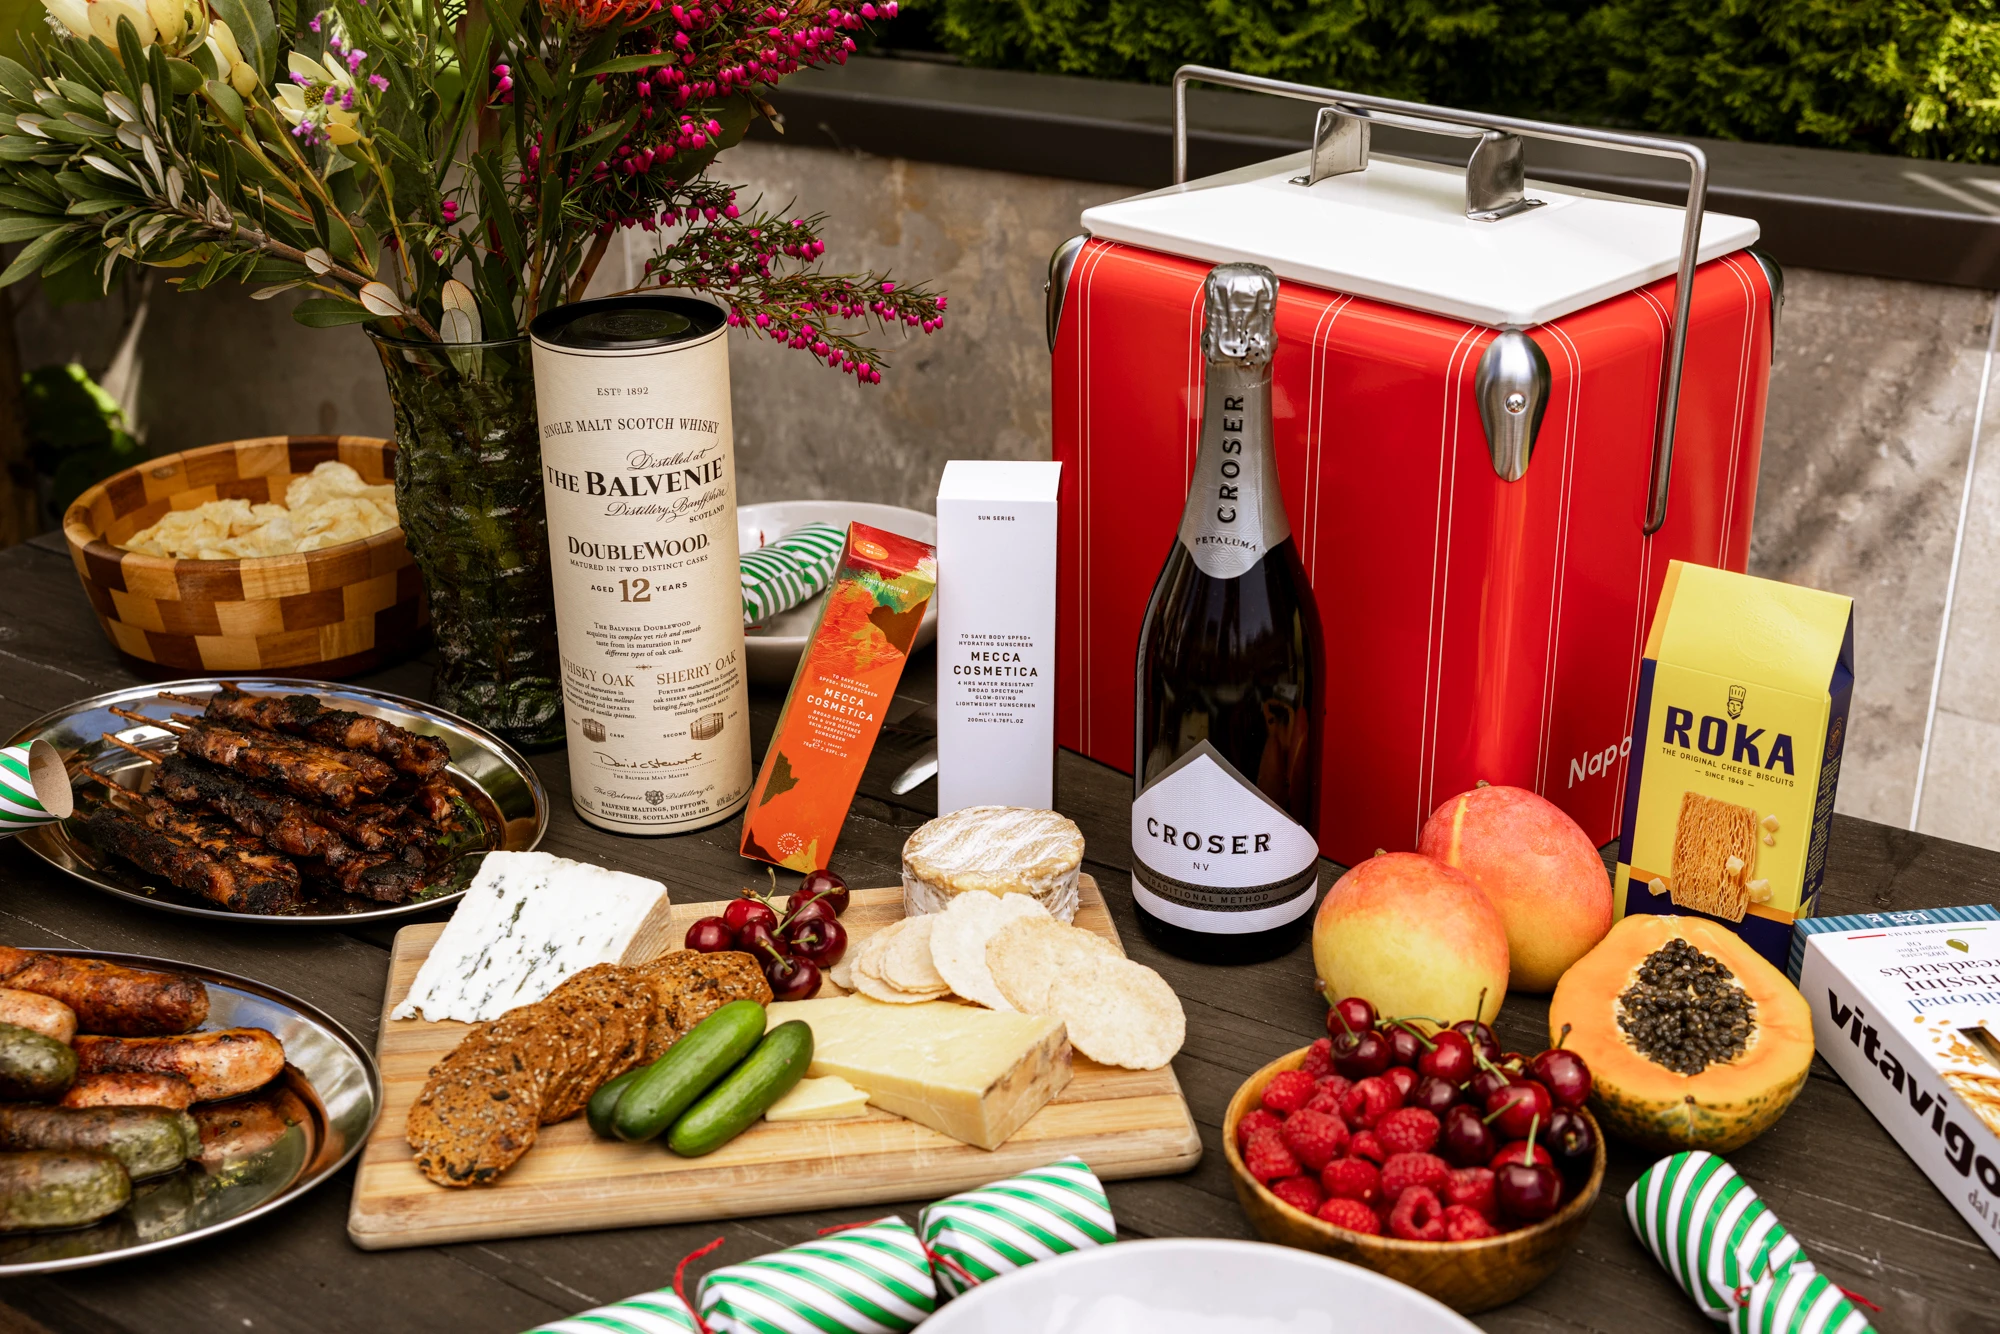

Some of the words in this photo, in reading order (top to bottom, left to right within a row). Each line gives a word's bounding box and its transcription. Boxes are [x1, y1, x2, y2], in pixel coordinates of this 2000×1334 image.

[627, 387, 649, 396] 1892
[544, 421, 574, 438] SINGLE
[576, 418, 612, 432] MALT
[618, 418, 674, 430] SCOTCH
[680, 418, 720, 434] WHISKY
[626, 449, 691, 471] Distilled
[1217, 395, 1244, 523] CROSER
[546, 464, 580, 493] THE
[666, 484, 729, 524] Banffshire
[689, 504, 725, 523] SCOTLAND
[1195, 536, 1256, 552] PETALUMA
[570, 558, 604, 572] MATURED
[642, 561, 684, 572] DISTINCT
[686, 554, 709, 566] CASKS
[590, 584, 615, 593] AGED
[618, 578, 651, 603] 12
[656, 581, 688, 592] YEARS
[864, 577, 886, 587] LIMITED
[887, 584, 909, 594] EDITION
[669, 630, 681, 638] and
[682, 624, 702, 635] smooth
[605, 649, 629, 658] different
[971, 652, 1020, 662] MECCA
[562, 654, 597, 682] WHISKY
[602, 672, 635, 687] OAK
[656, 663, 711, 685] SHERRY
[716, 650, 737, 670] OAK
[954, 666, 1038, 677] COSMETICA
[688, 680, 714, 690] maturation
[840, 683, 878, 698] SUPERSCREEN
[824, 688, 864, 707] MECCA
[674, 707, 698, 716] resulting
[807, 695, 873, 722] COSMETICA
[1664, 705, 1794, 776] ROKA
[1568, 736, 1632, 788] Napo
[1662, 747, 1676, 756] THE
[1680, 752, 1717, 768] ORIGINAL
[1722, 764, 1752, 776] CHEESE
[1756, 772, 1794, 788] BISCUITS
[1705, 770, 1724, 780] SINCE
[1728, 776, 1744, 786] 1949
[594, 786, 606, 795] The
[607, 790, 642, 800] Balvenie
[602, 802, 630, 812] BALVENIE
[1146, 817, 1272, 855] CROSER
[1146, 876, 1214, 902] TRADITIONAL
[1220, 894, 1269, 904] METHOD
[1866, 914, 1884, 923] g
[1890, 912, 1930, 924] 125
[1907, 992, 2000, 1014] itional
[1828, 988, 2000, 1198] vitavigo
[1968, 1189, 1989, 1219] dal
